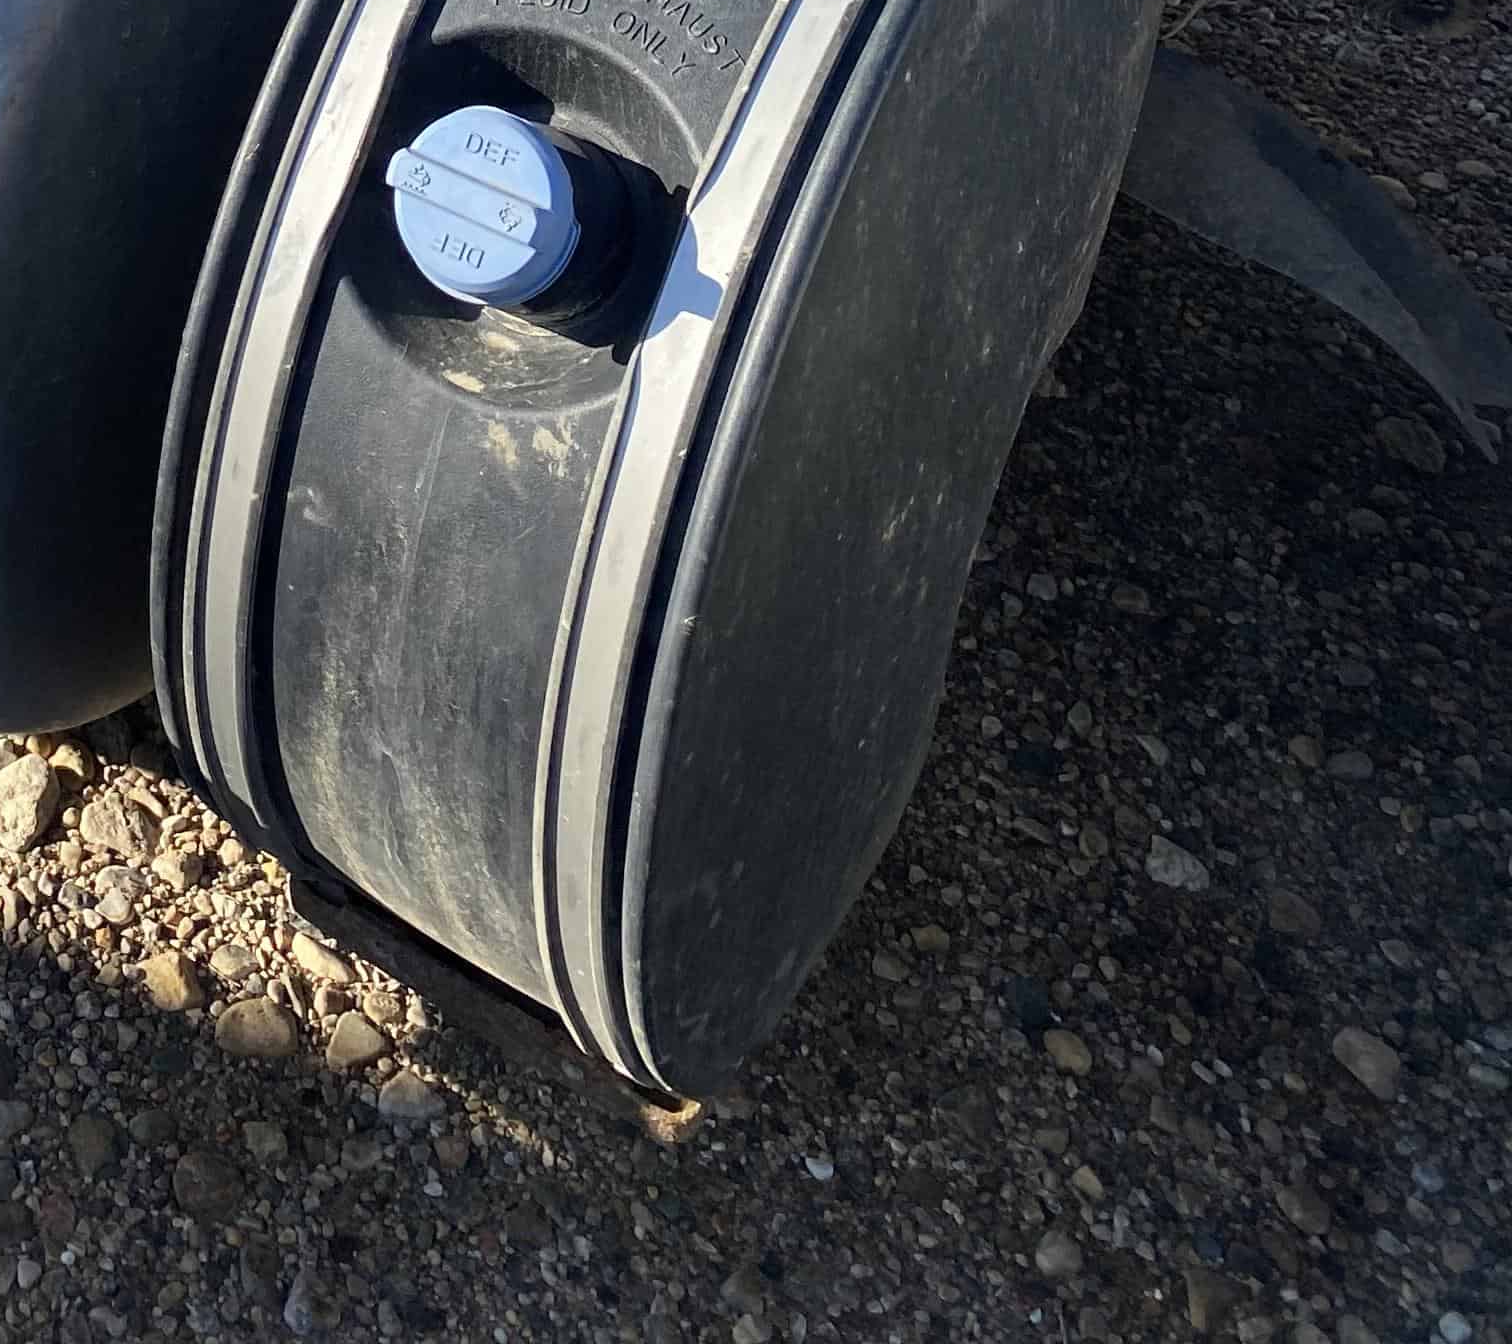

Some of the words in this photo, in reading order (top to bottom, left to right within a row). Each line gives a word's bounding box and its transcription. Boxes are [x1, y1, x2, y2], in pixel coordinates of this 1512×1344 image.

[611, 11, 697, 76] ONLY
[465, 132, 521, 166] DEF
[431, 234, 486, 269] DEF
